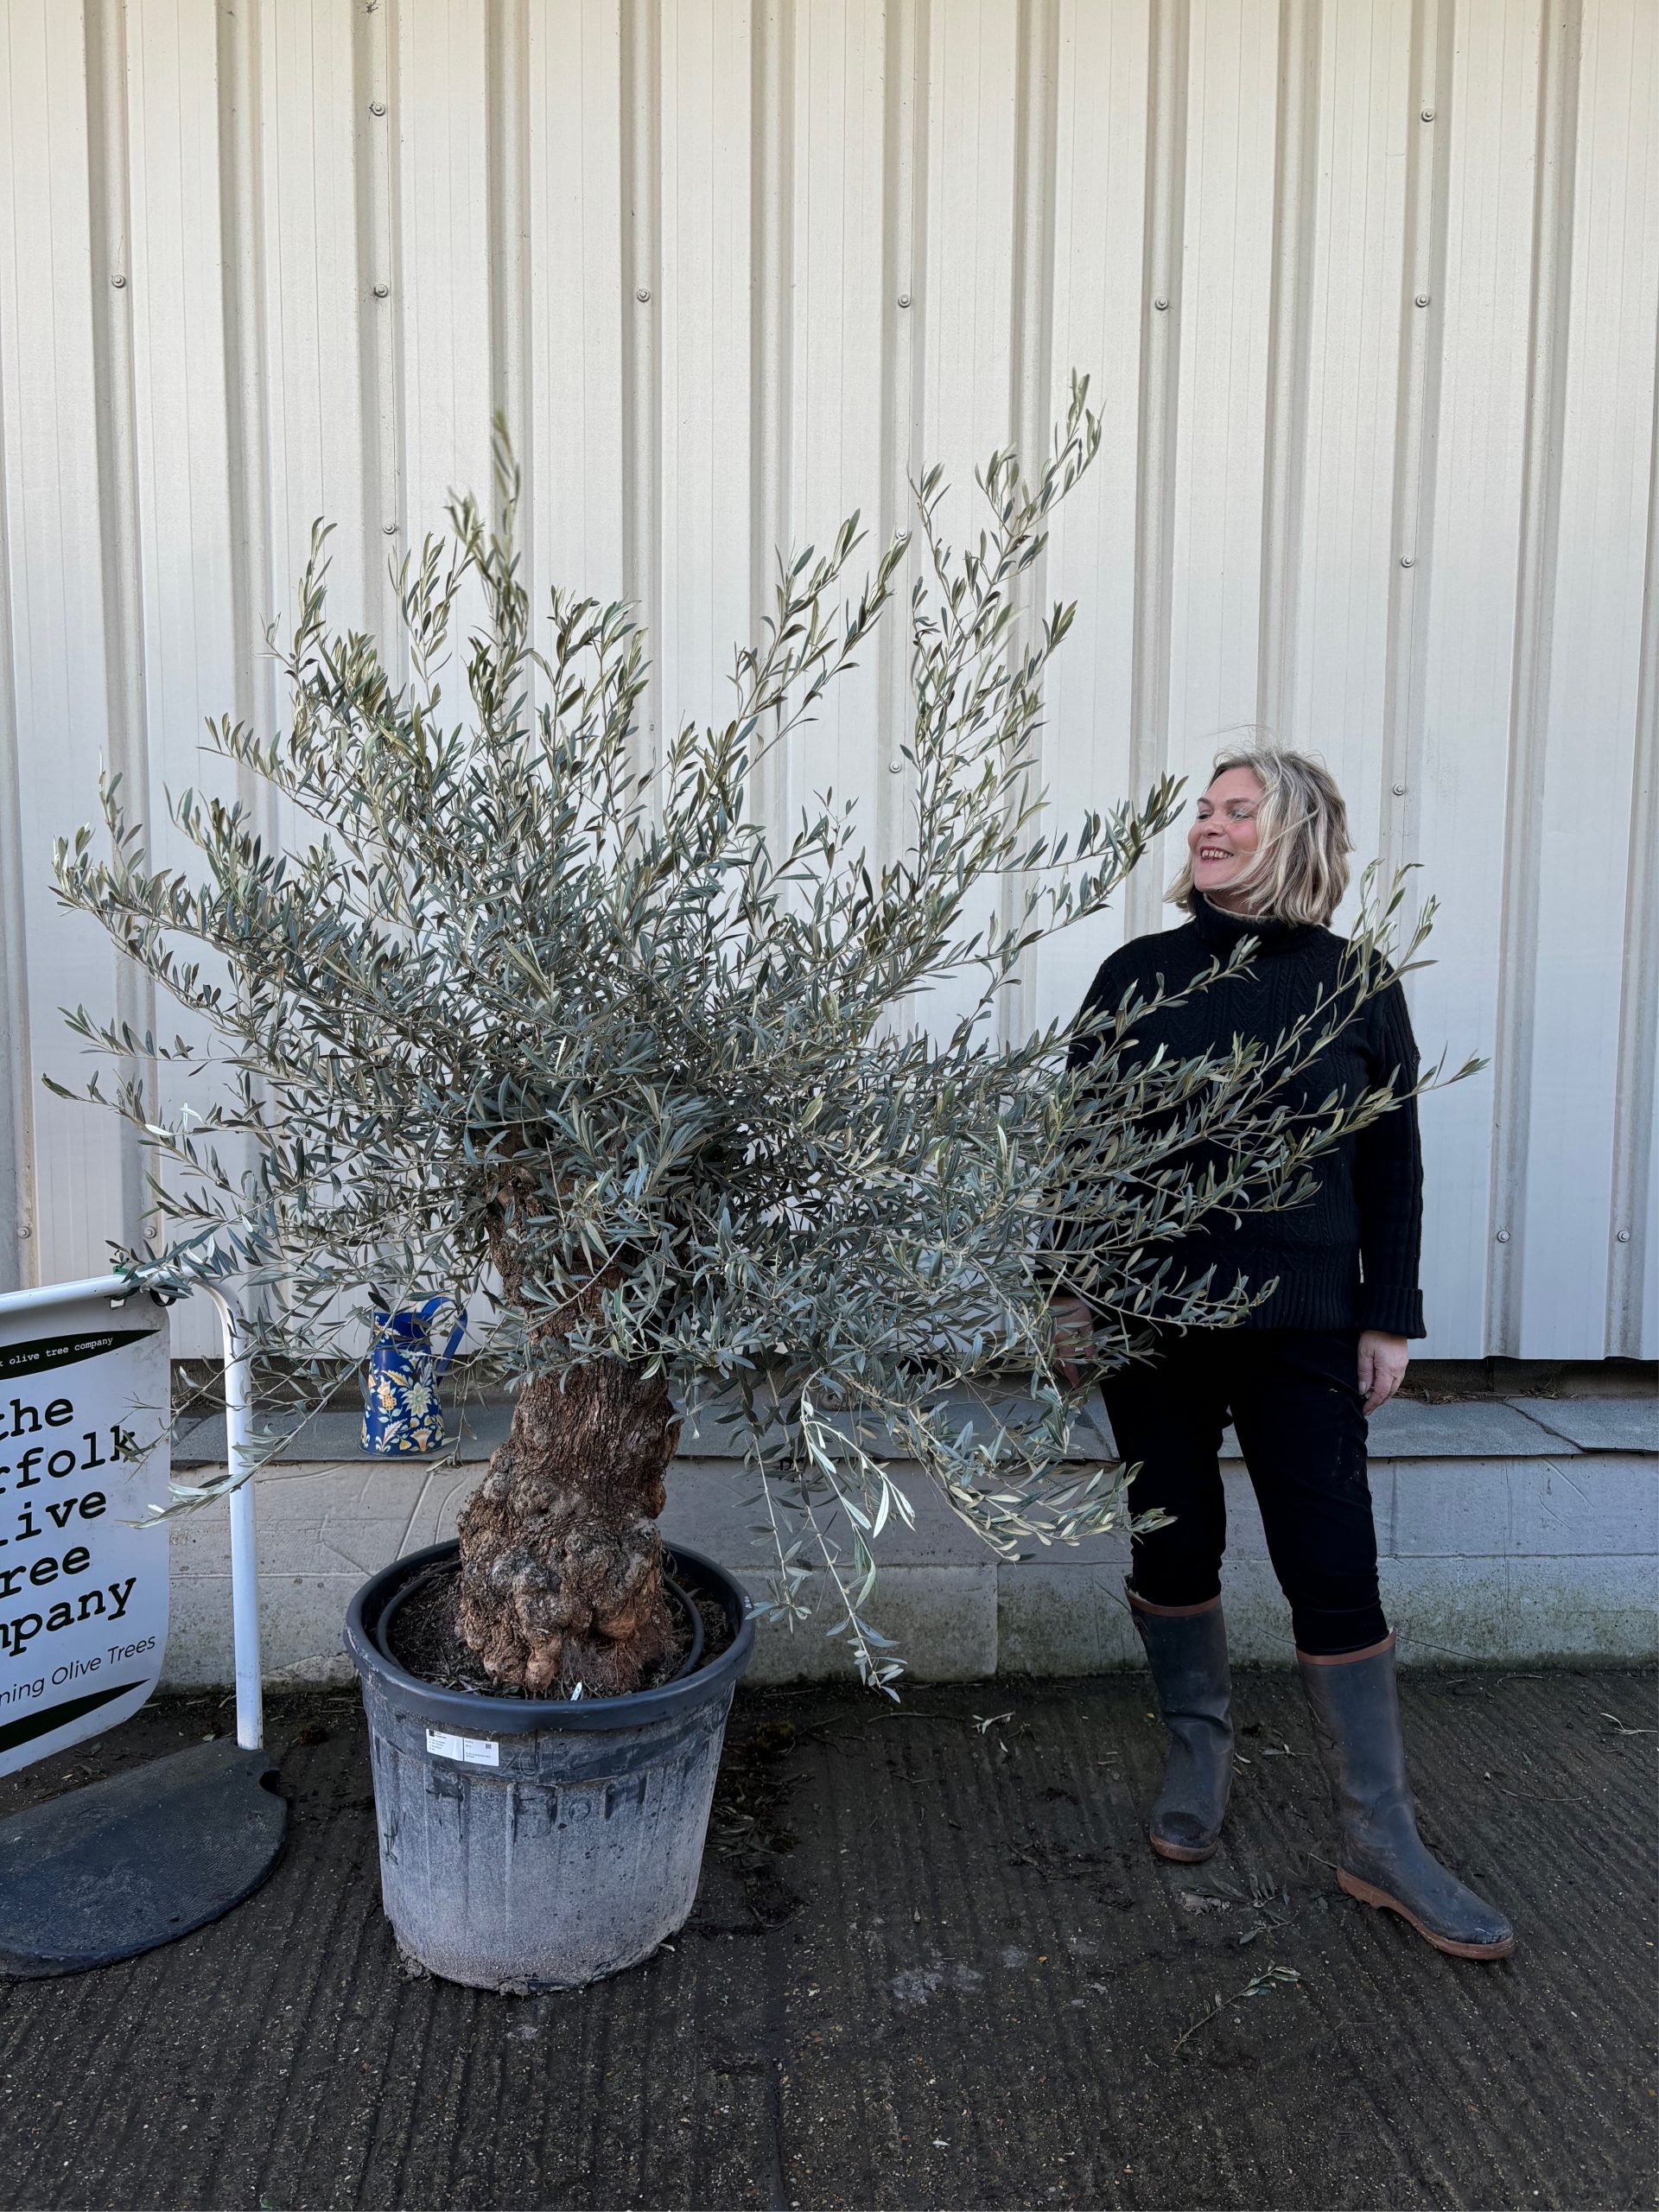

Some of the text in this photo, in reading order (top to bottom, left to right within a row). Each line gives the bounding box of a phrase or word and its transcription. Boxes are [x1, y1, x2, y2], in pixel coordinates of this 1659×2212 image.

[9, 1351, 40, 1365] olive
[46, 1345, 69, 1357] tree
[74, 1337, 113, 1351] company
[0, 1491, 106, 1548] ive
[52, 1656, 102, 1685] Olive
[107, 1636, 156, 1664] Trees
